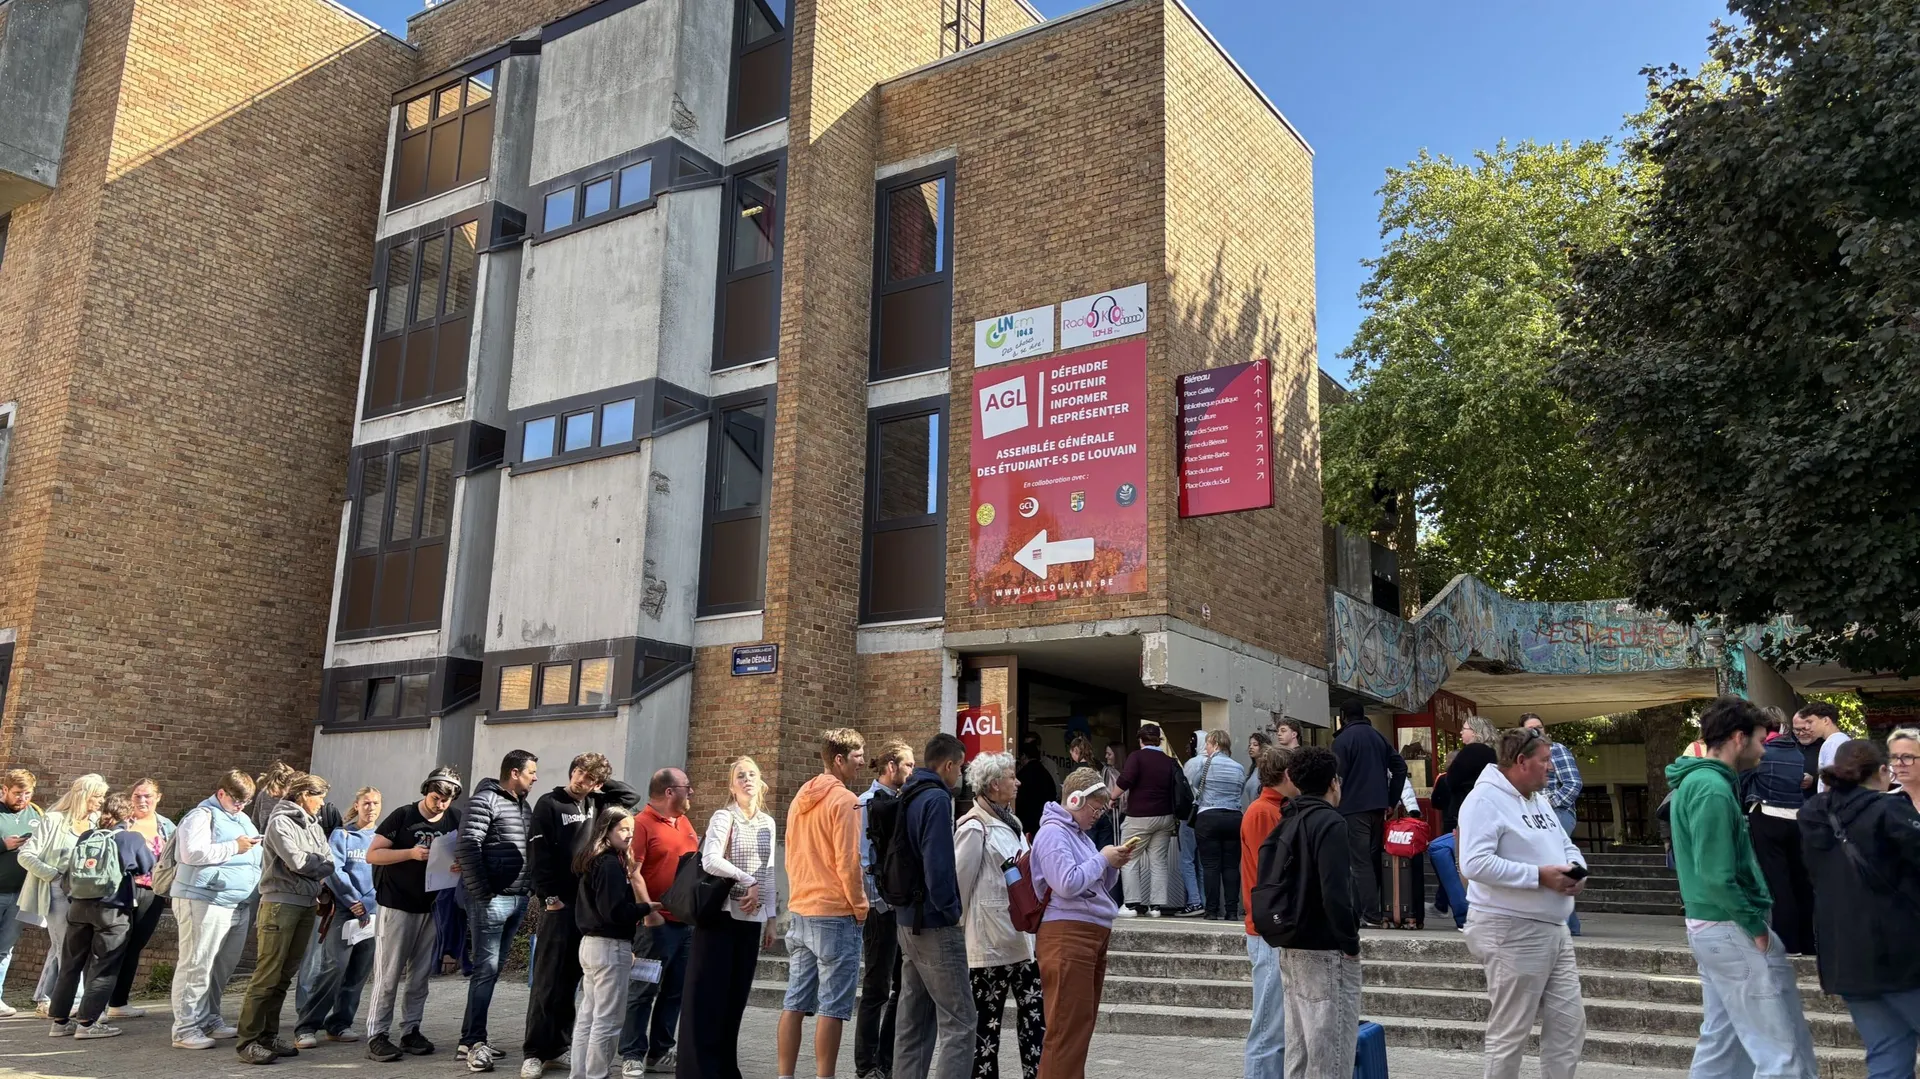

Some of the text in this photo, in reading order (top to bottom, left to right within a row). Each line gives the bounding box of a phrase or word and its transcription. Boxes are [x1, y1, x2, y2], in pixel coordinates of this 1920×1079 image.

[1017, 328, 1033, 337] 104.8
[1093, 327, 1113, 338] 104.8
[1002, 337, 1034, 356] Des choses
[1051, 360, 1108, 379] DÉFENDRE
[1051, 376, 1106, 394] SOUTENIR
[1184, 374, 1210, 384] Biéreau
[985, 389, 1027, 412] AGL
[1050, 391, 1108, 409] INFORMER
[1216, 396, 1238, 406] publique
[1050, 403, 1129, 425] REPRÉSENTER
[1198, 413, 1216, 421] Culture
[1206, 424, 1228, 433] Sciences
[996, 432, 1115, 460] ASSEMBLÉE GÉNÉRALE
[977, 466, 996, 477] DES
[1071, 452, 1085, 462] DE
[1088, 444, 1137, 460] LOUVAIN
[1206, 465, 1223, 473] Levant
[1032, 476, 1070, 487] collaboration
[1072, 474, 1084, 482] avec
[995, 578, 1114, 597] WWW.AGLOUVAIN.BE
[752, 654, 772, 664] DÉDALE
[961, 716, 1002, 736] AGL
[1522, 814, 1556, 829] GUES
[1387, 830, 1414, 845] NIKE
